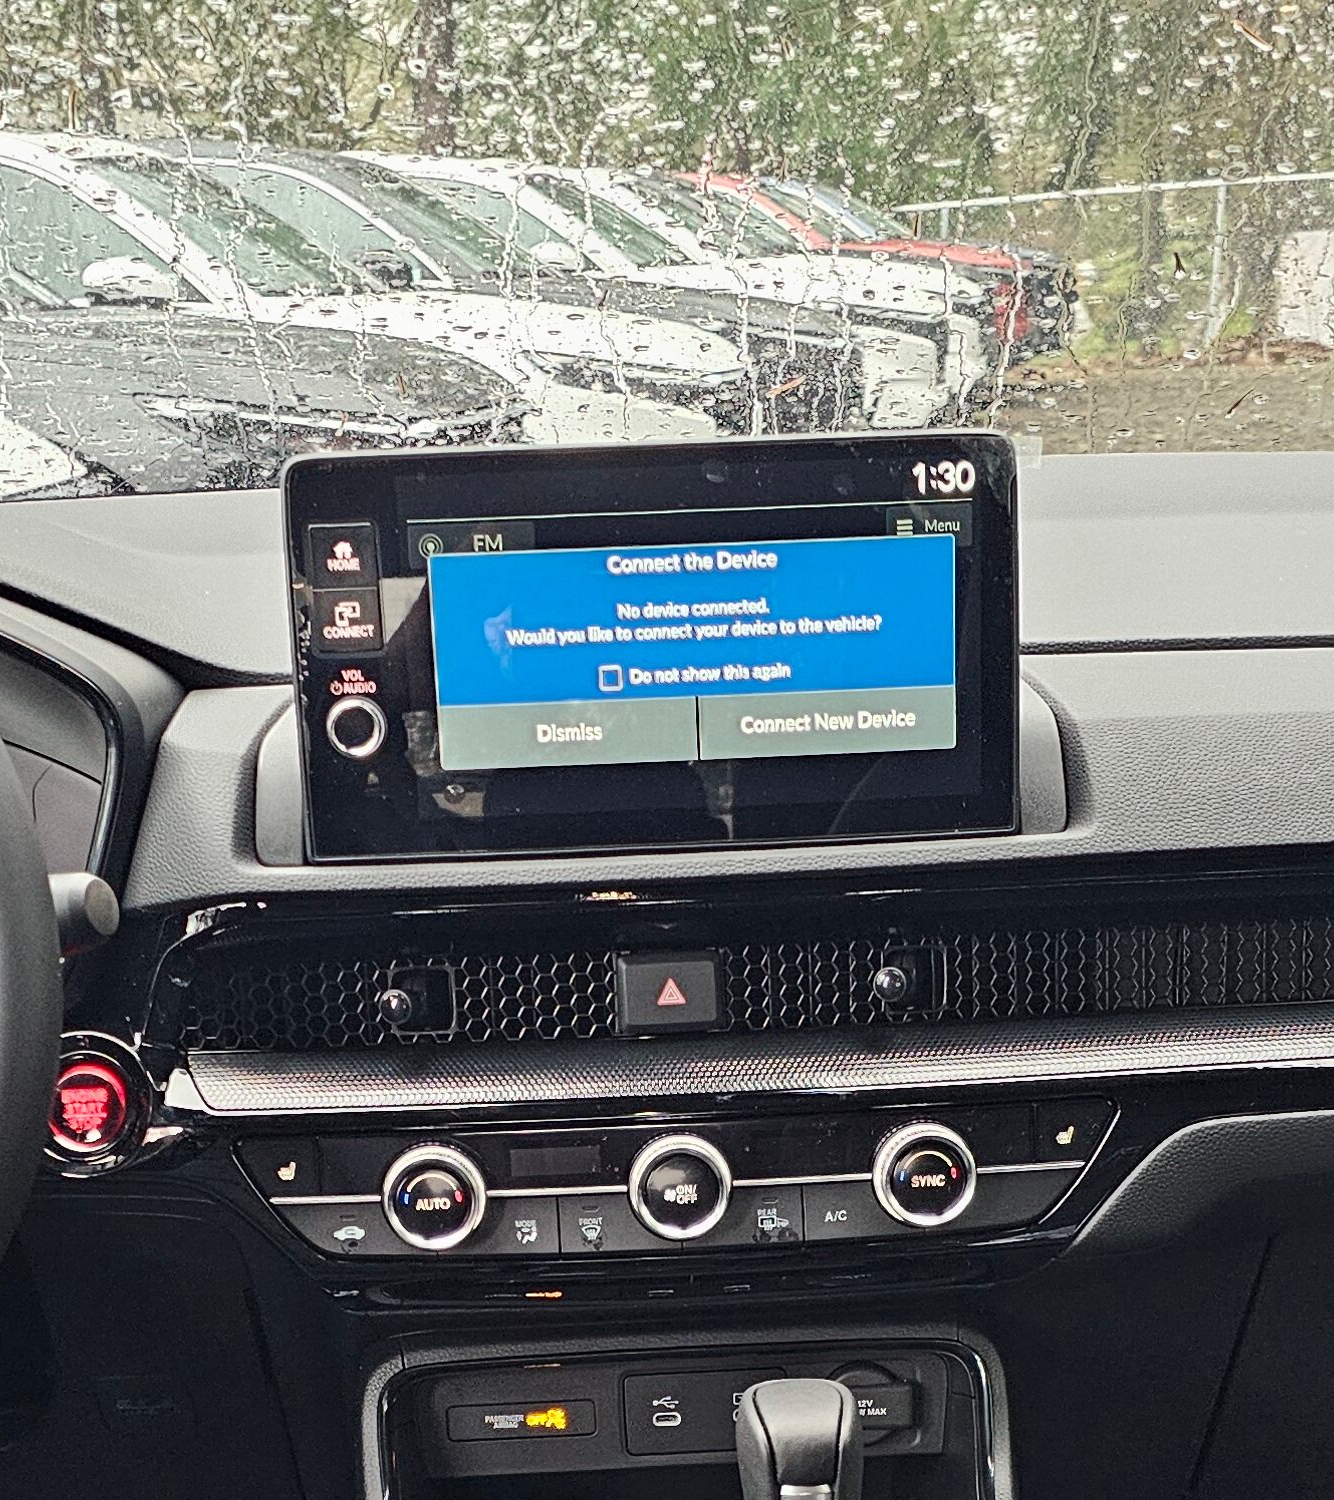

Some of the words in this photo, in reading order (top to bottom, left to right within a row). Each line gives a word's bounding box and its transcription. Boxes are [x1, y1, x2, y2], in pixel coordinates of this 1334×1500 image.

[912, 461, 975, 495] 1:30
[924, 519, 961, 533] Menu
[472, 533, 503, 552] FM
[327, 558, 361, 572] HOME
[606, 553, 681, 576] Connect
[685, 552, 713, 572] the
[717, 549, 778, 570] Device
[617, 603, 640, 620] No
[642, 601, 689, 619] device
[692, 597, 770, 617] connected.
[323, 625, 374, 639] CONNECT
[506, 629, 555, 647] Would
[557, 630, 586, 647] you
[587, 627, 613, 643] like
[615, 626, 631, 642] to
[635, 623, 693, 641] connect
[695, 623, 729, 641] your
[730, 618, 777, 637] device
[779, 618, 796, 635] to
[798, 616, 823, 634] the
[825, 614, 883, 633] vehicle?
[341, 669, 364, 682] VOL
[629, 668, 651, 685] Do
[654, 667, 679, 684] not
[681, 666, 721, 683] show
[723, 664, 750, 681] this
[752, 663, 791, 681] again
[343, 681, 376, 694] AUDIO
[740, 714, 811, 734] Connect
[814, 711, 854, 731] New
[857, 709, 916, 730] Device
[536, 722, 603, 743] Dismiss
[911, 1175, 946, 1188] SYNC
[416, 1198, 450, 1211] AUTO
[579, 1217, 603, 1226] FRONT
[824, 1209, 847, 1222] A/C
[857, 1399, 873, 1408] 12V
[867, 1407, 887, 1416] MAX
